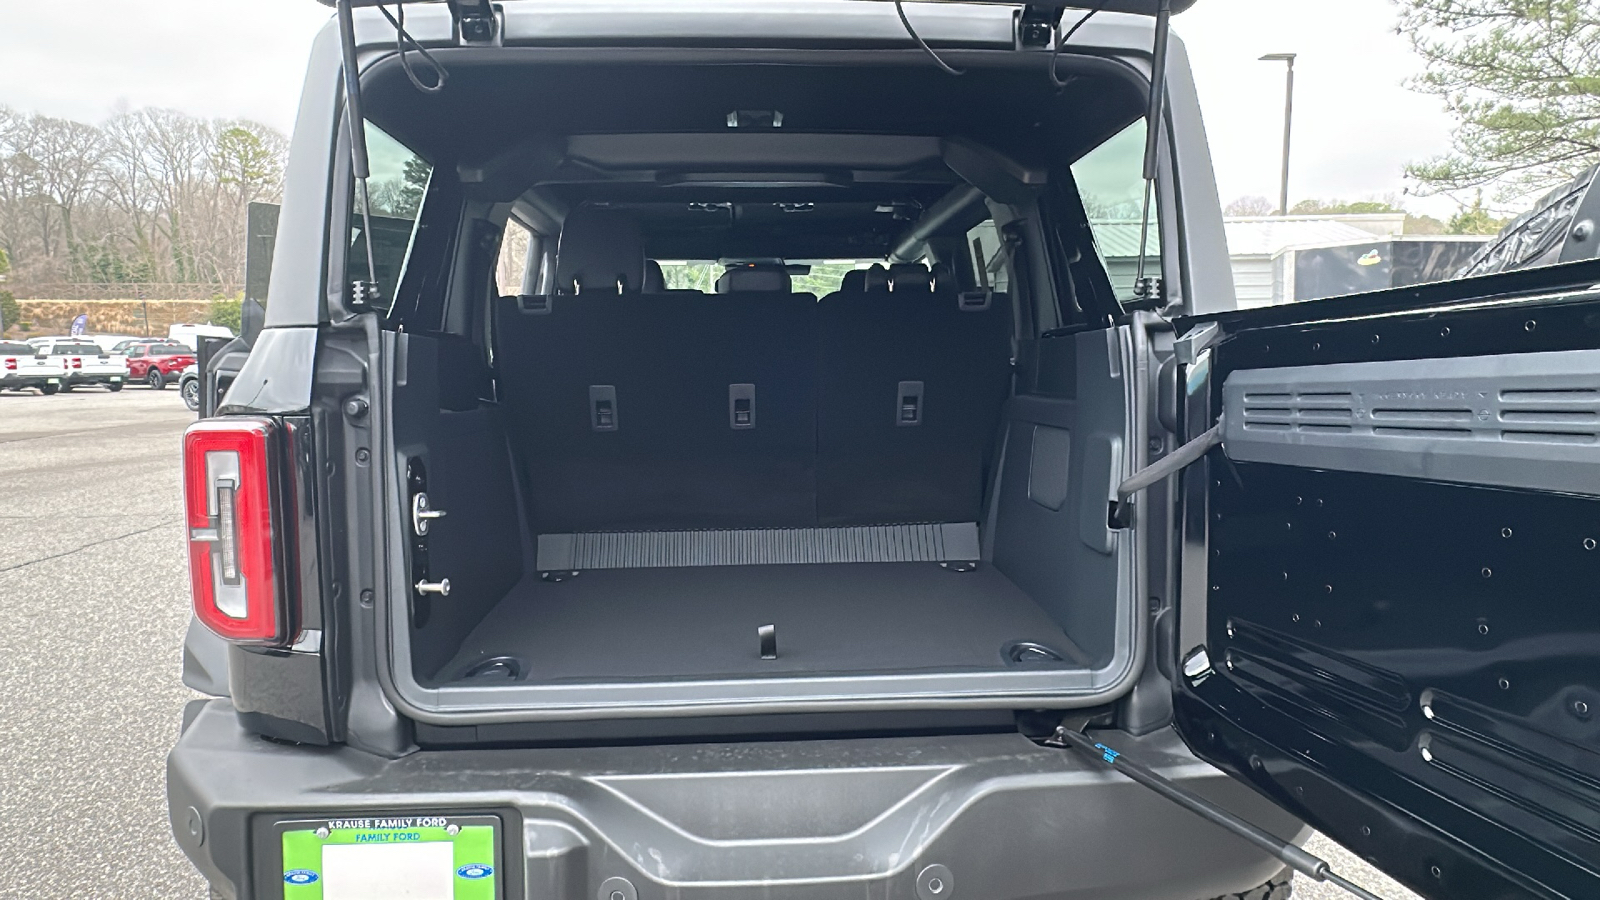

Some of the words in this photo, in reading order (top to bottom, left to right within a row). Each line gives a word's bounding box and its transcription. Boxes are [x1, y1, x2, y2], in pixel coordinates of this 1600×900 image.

[328, 820, 371, 829] KRAUSE
[374, 818, 412, 828] FAMILY
[416, 817, 447, 827] FORD
[355, 833, 390, 842] FAMILY
[393, 832, 420, 841] FORD
